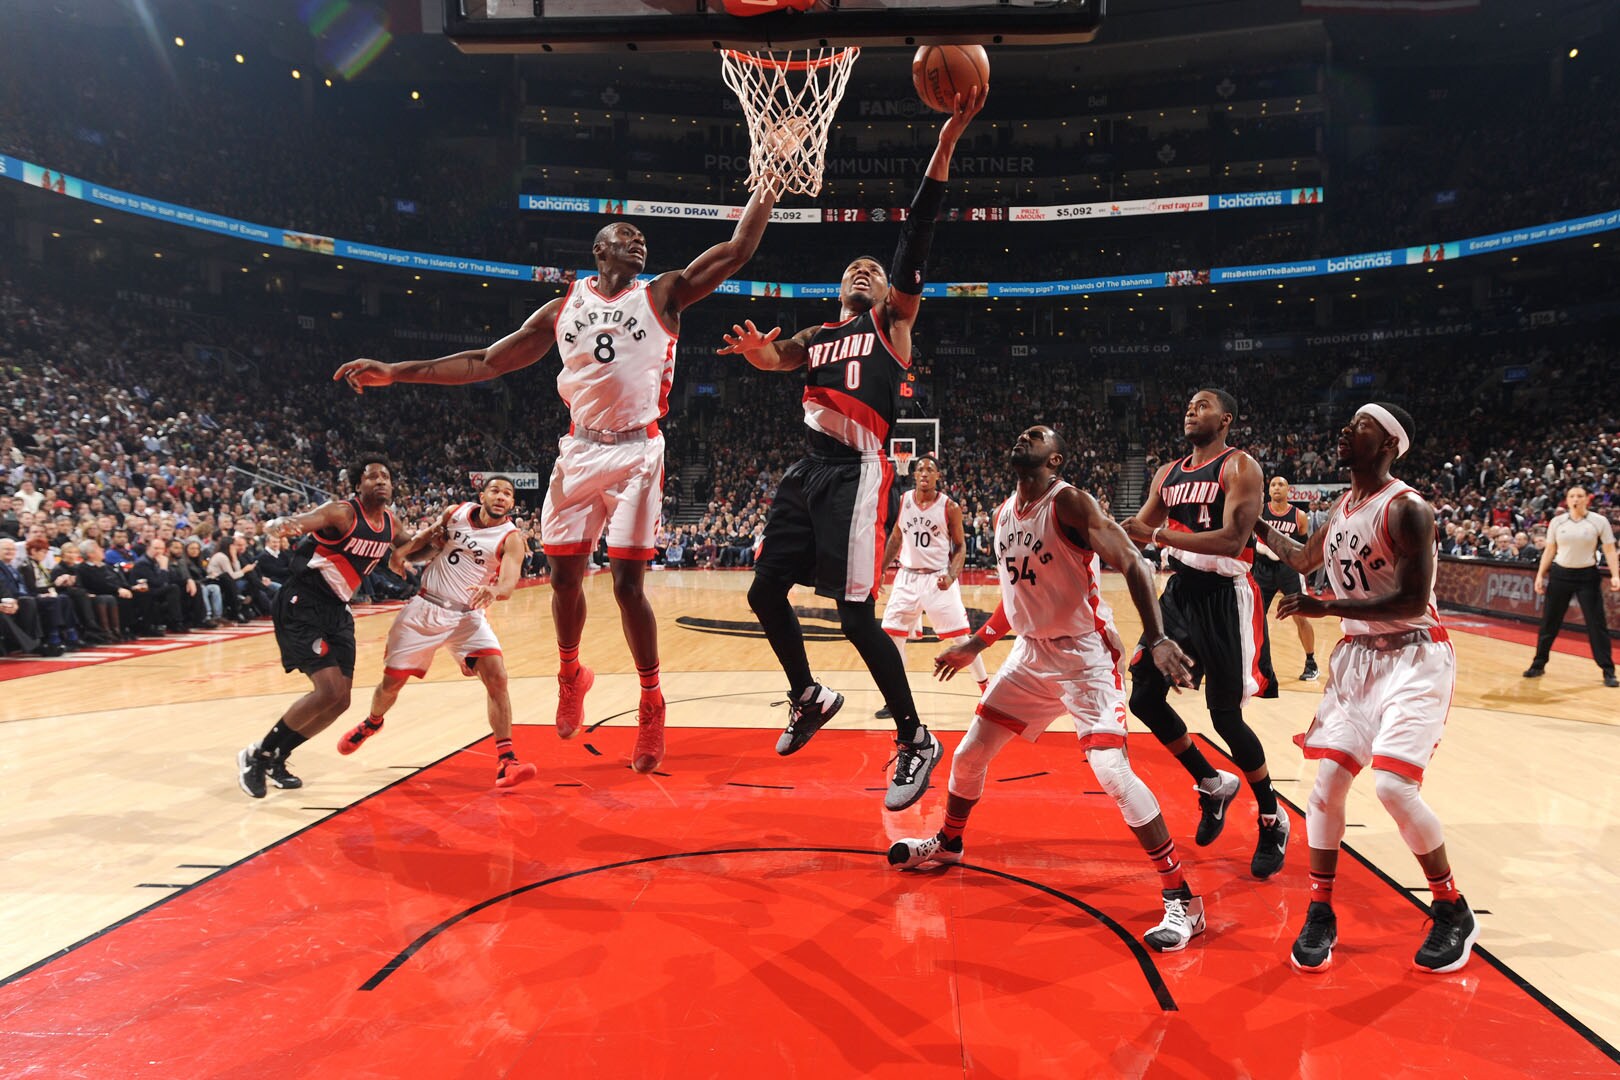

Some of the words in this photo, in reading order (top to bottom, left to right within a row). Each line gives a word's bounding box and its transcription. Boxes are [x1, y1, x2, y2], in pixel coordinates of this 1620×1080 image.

[529, 195, 590, 211] bahamas
[1218, 194, 1282, 208] bahamas
[92, 188, 126, 205] Escape
[128, 198, 139, 208] to
[140, 201, 157, 213] the
[158, 206, 175, 216] sun
[176, 211, 194, 221] and
[195, 216, 228, 229] warmth
[229, 222, 239, 232] of
[239, 224, 269, 238] Exuma
[650, 205, 681, 214] 50/50
[684, 207, 719, 216] DRAW
[844, 209, 859, 221] 27
[971, 208, 986, 221] 24
[1056, 206, 1092, 217] $5,092
[1469, 239, 1500, 250] Escape
[1502, 236, 1512, 244] to
[1513, 233, 1529, 242] the
[1530, 230, 1547, 239] sun
[1548, 226, 1567, 236] and
[1568, 218, 1605, 232] warmth
[1606, 214, 1618, 224] of
[347, 245, 387, 260] Swimming
[389, 255, 410, 263] pigs?
[413, 256, 429, 265] The
[430, 258, 457, 268] Islands
[470, 263, 484, 272] The
[485, 265, 519, 276] Bahamas
[1327, 255, 1392, 272] bahamas
[1221, 265, 1316, 279] #ItsBetterInTheBahamas
[801, 286, 825, 294] Escape
[999, 286, 1035, 294] Swimming
[1036, 286, 1054, 294] pigs?
[1071, 282, 1095, 290] Islands
[1120, 278, 1153, 286] Bahamas
[565, 310, 646, 344] RAPTORS
[1305, 333, 1369, 345] TORONTO
[1373, 328, 1421, 341] MAPLE
[594, 333, 616, 363] 8
[845, 360, 861, 390] 0
[512, 478, 537, 488] IGHT
[1162, 481, 1220, 507] PORTLAND
[1286, 485, 1320, 501] Coors
[1198, 504, 1211, 528] 4
[453, 531, 485, 565] PTORS
[913, 531, 931, 548] 10
[448, 548, 464, 565] 6
[1005, 556, 1037, 586] 54
[1340, 560, 1370, 591] 31
[1486, 573, 1534, 603] pizza
